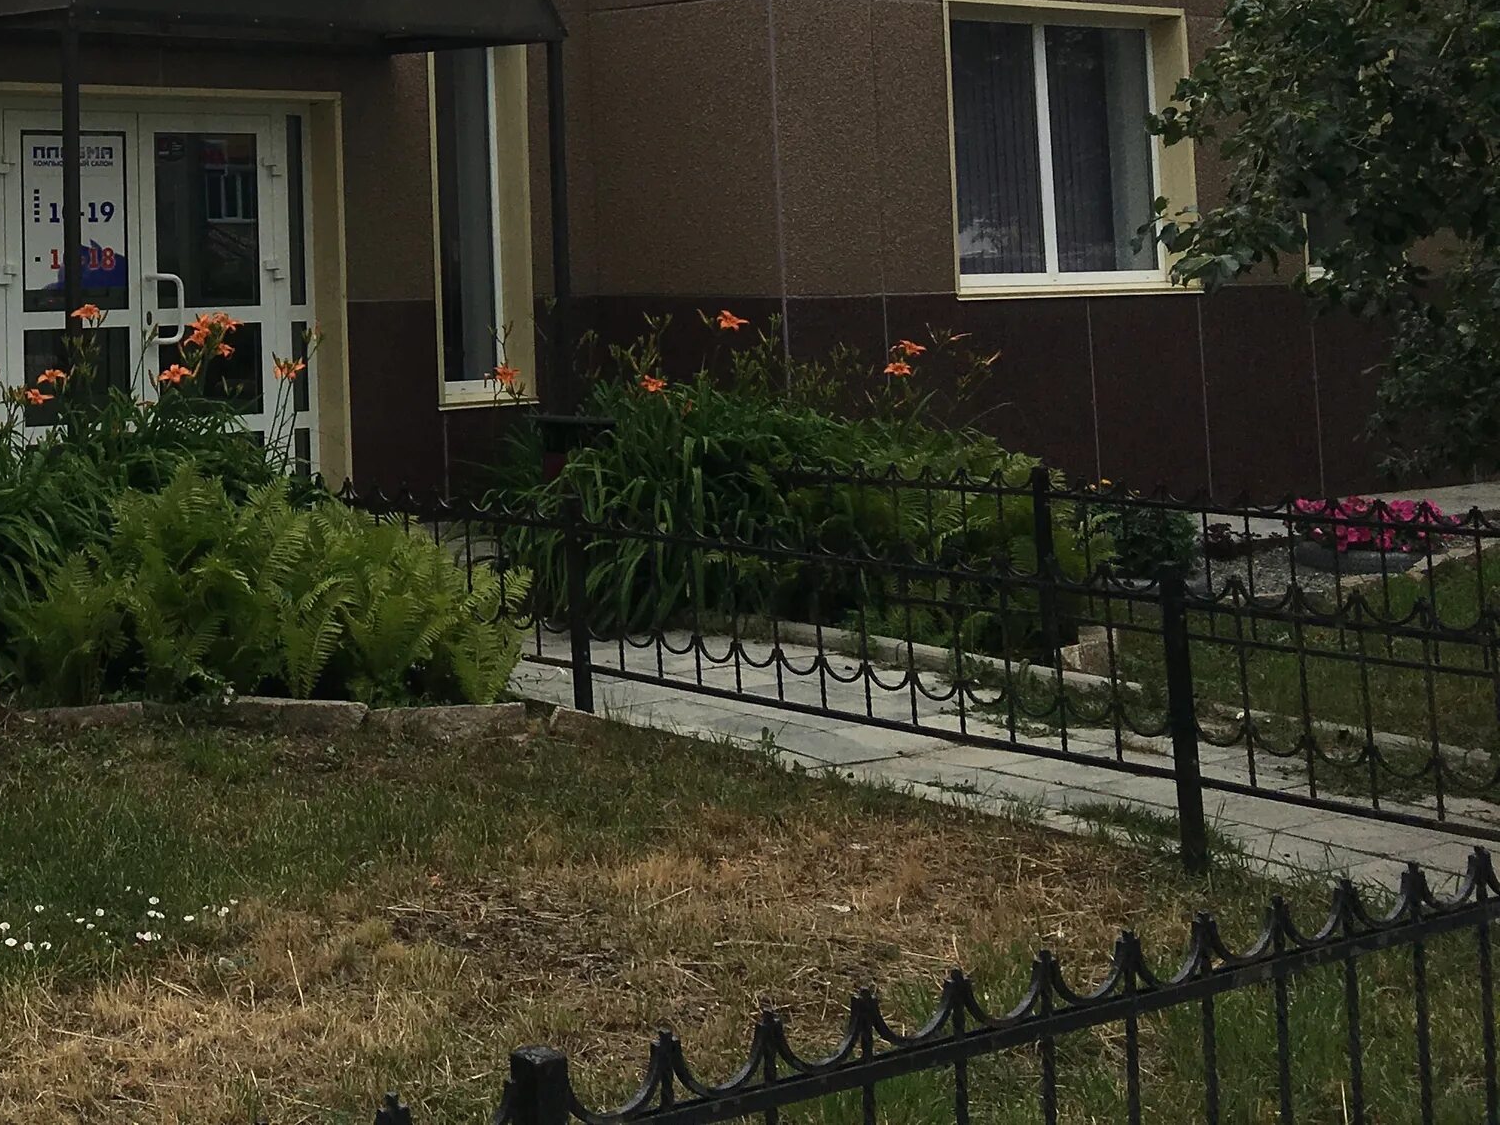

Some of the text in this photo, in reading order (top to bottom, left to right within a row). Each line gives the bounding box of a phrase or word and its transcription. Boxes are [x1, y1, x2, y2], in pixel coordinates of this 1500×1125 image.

[32, 146, 113, 159] ПЛМА
[49, 202, 115, 223] 1-19
[50, 247, 116, 270] 1-18
